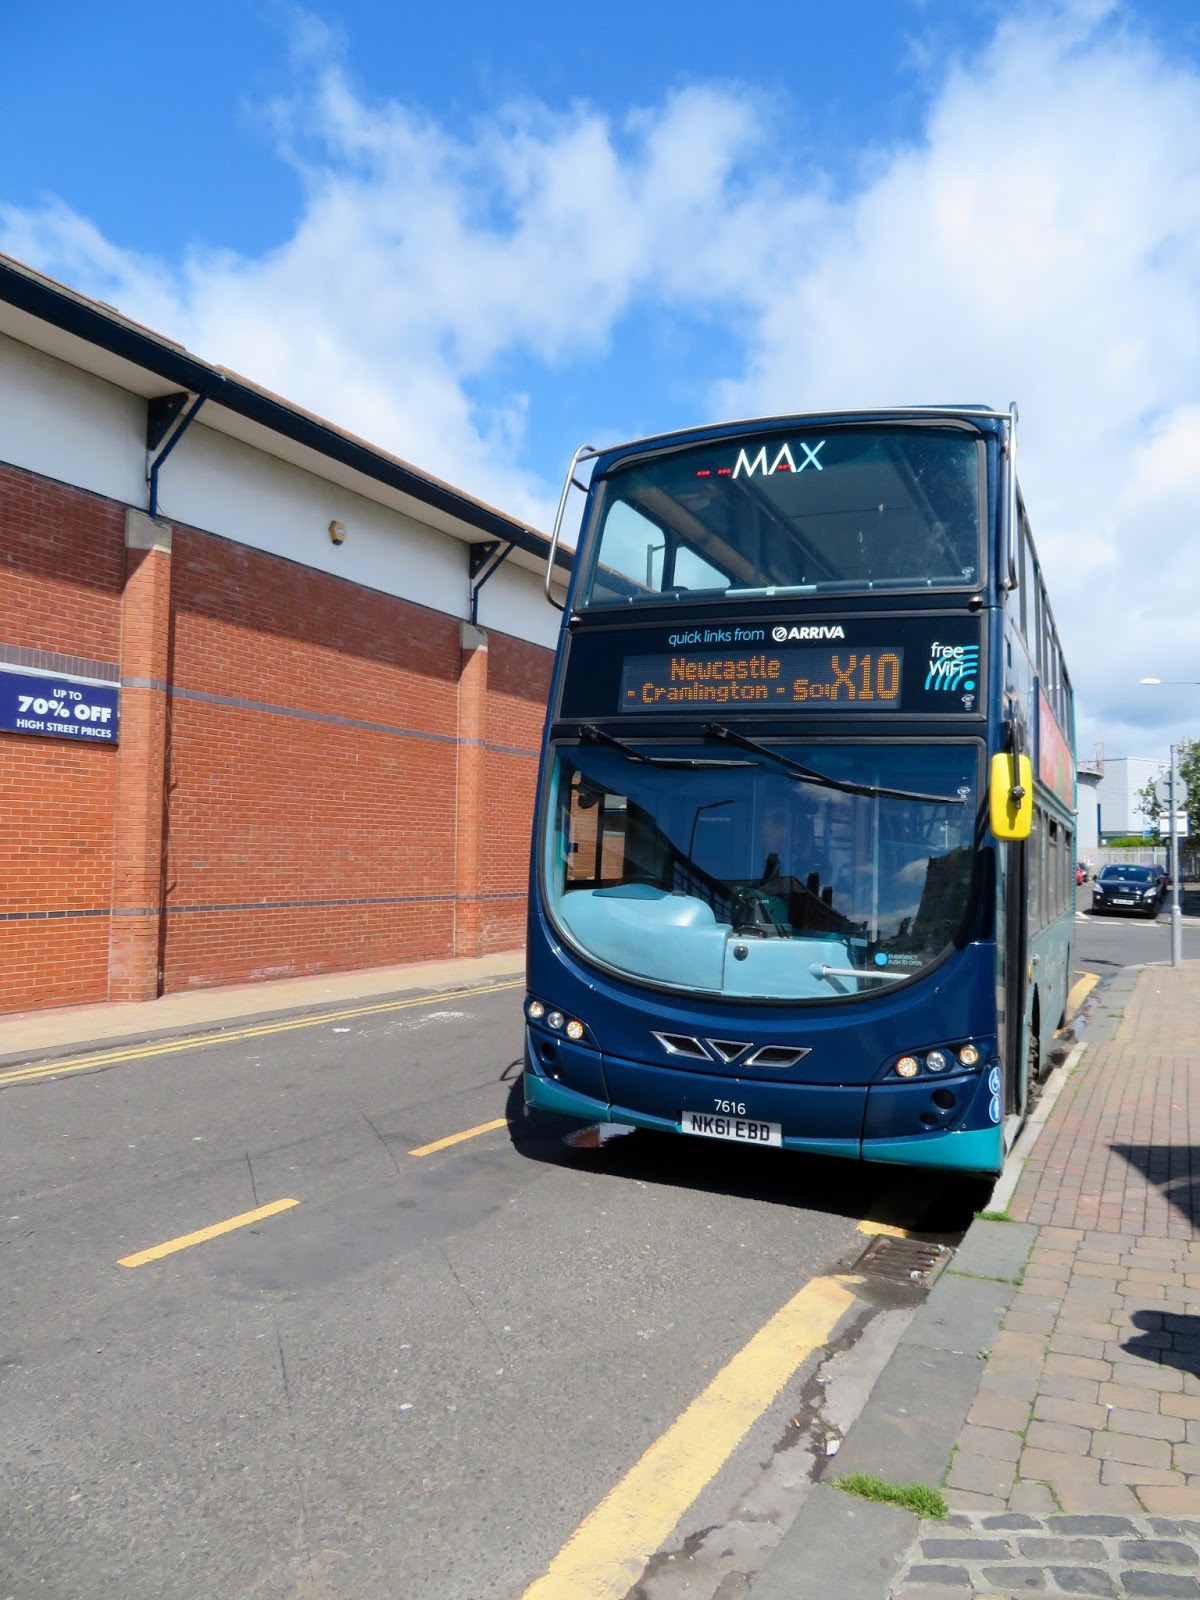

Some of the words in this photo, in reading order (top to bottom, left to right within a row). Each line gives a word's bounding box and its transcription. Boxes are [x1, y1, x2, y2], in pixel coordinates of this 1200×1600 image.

[732, 440, 826, 479] MAX
[668, 630, 702, 647] quick
[703, 628, 732, 643] links
[734, 627, 765, 641] from
[788, 626, 845, 640] ARRIVA
[931, 641, 964, 659] free
[671, 655, 780, 681] Newcastle
[831, 653, 899, 700] X10
[929, 660, 964, 677] WiFi
[53, 688, 67, 699] UP
[68, 690, 82, 701] TO
[642, 681, 768, 703] Cramlington
[18, 695, 70, 718] 70%
[74, 704, 112, 723] OFF
[16, 718, 44, 730] HIGH
[46, 722, 79, 735] STREET
[81, 726, 112, 738] PRICES
[714, 1099, 746, 1115] 7616
[692, 1115, 730, 1136] NK61
[735, 1121, 770, 1141] EBD
